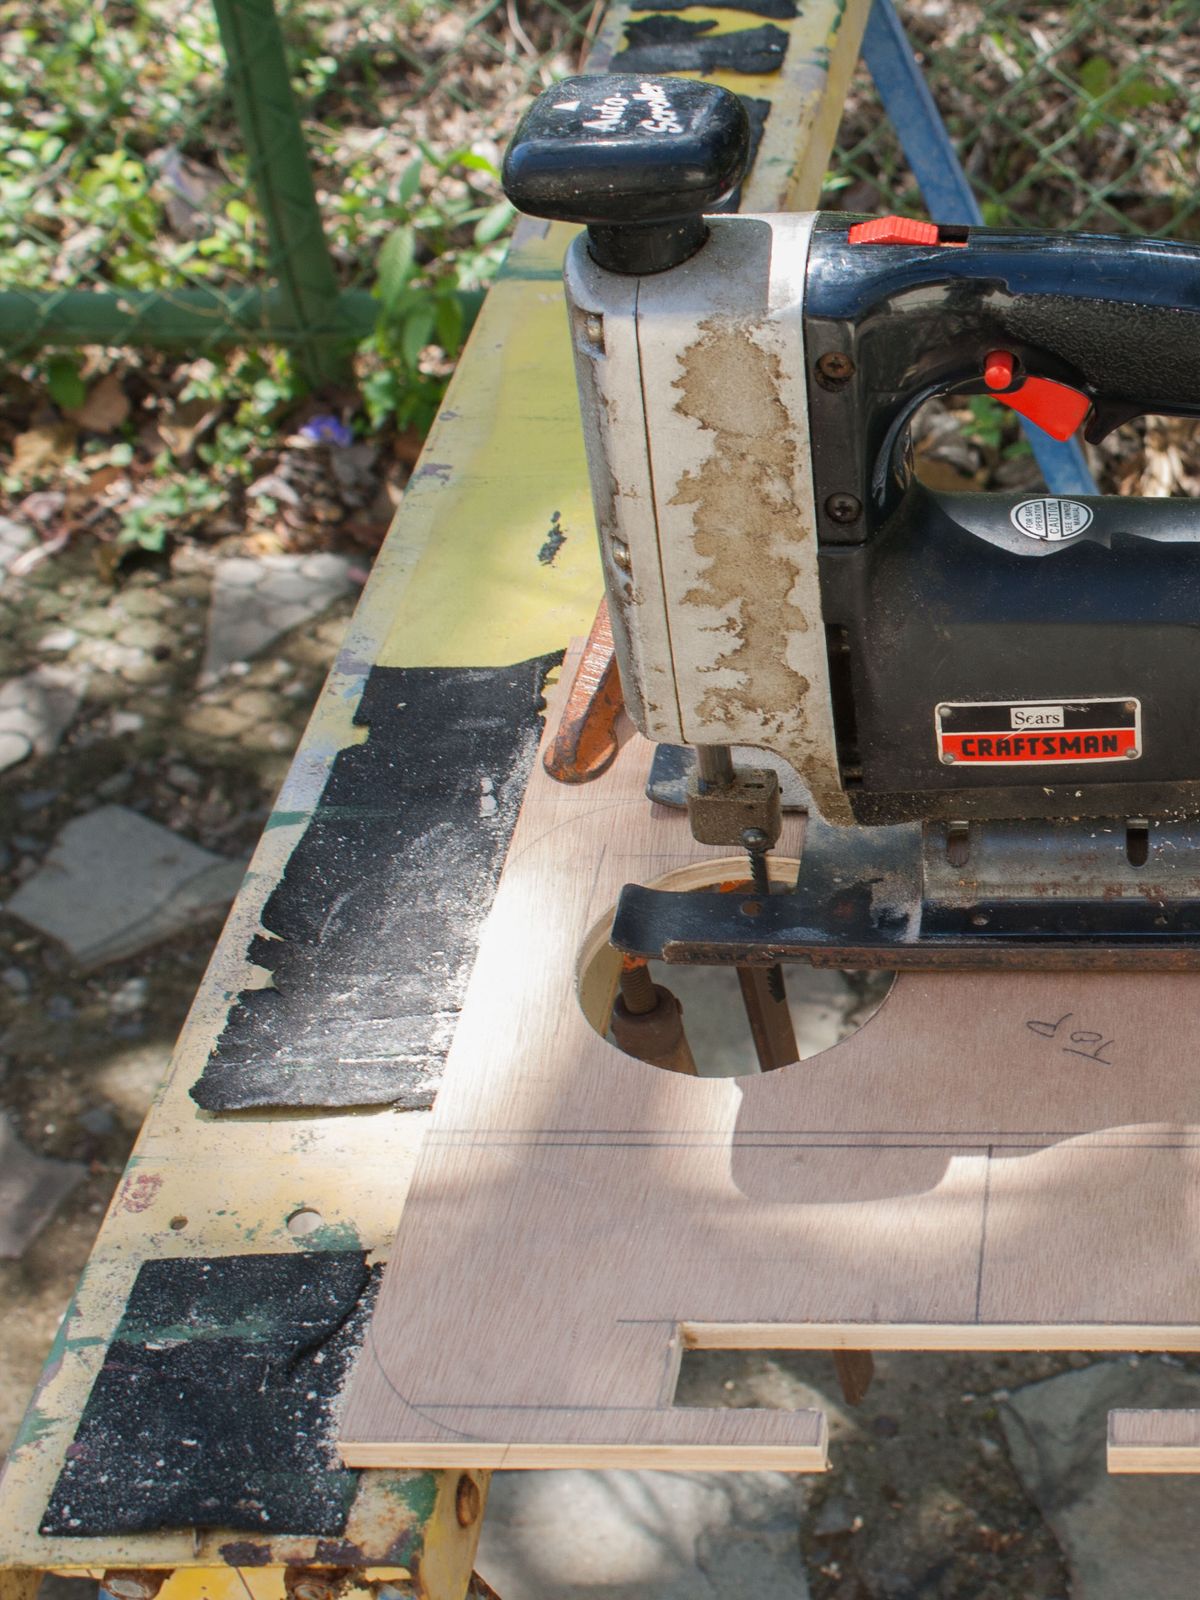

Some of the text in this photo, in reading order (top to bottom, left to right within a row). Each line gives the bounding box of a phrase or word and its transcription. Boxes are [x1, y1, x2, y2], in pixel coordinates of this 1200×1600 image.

[1025, 505, 1034, 529] FOR SAFE
[1034, 504, 1043, 531] OPERATION
[1047, 502, 1060, 535] CAUTION
[1064, 521, 1073, 532] SEE
[1073, 506, 1081, 526] MANUAL
[1015, 711, 1060, 726] Sears
[961, 735, 1119, 757] CRAFTSMAN
